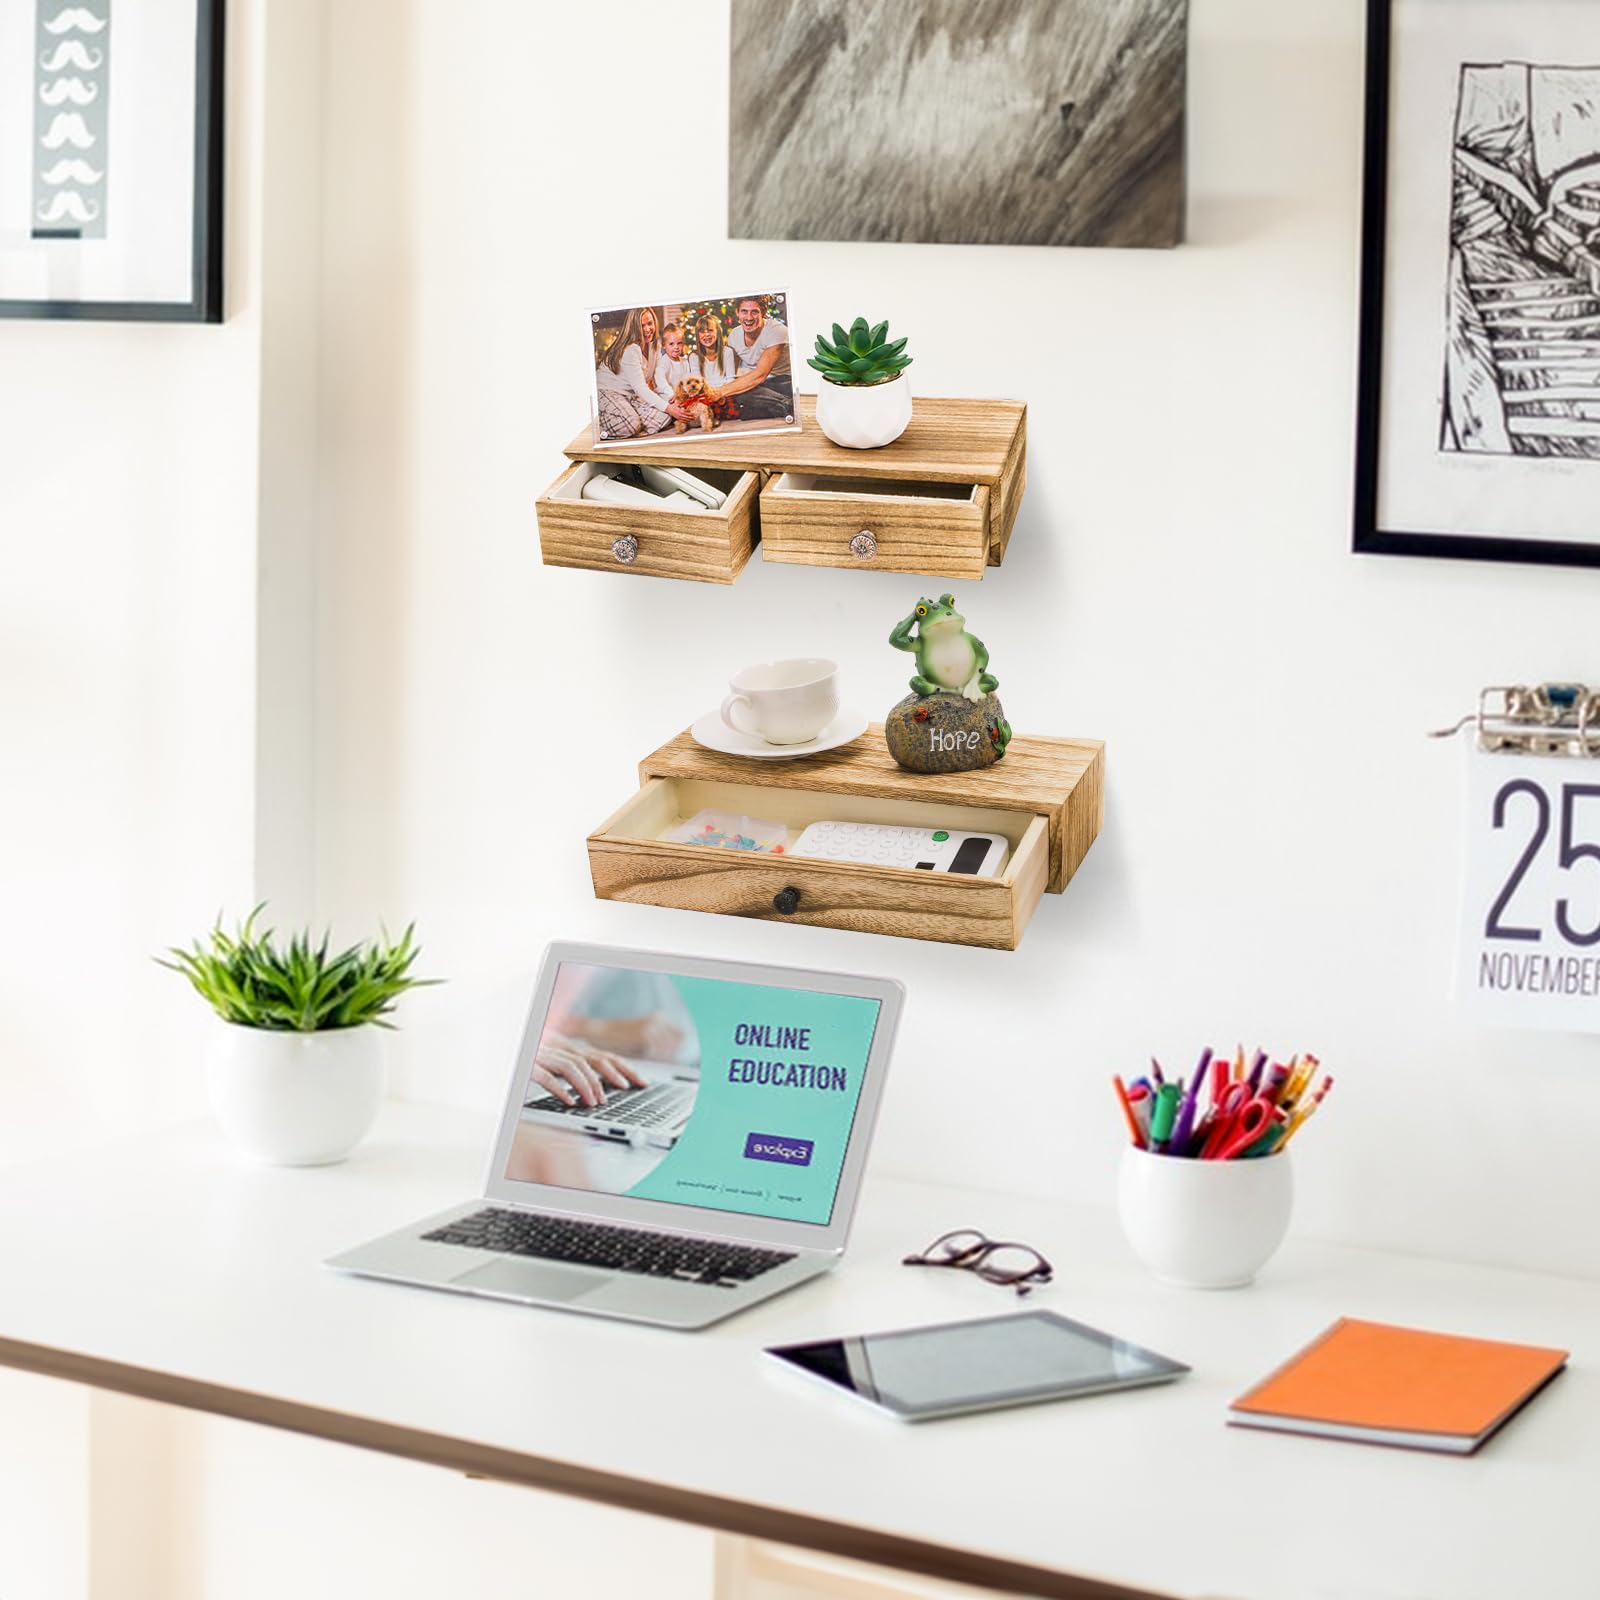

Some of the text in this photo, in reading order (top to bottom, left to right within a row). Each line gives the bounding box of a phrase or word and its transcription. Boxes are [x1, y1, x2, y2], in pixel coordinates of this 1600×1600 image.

[1485, 778, 1600, 947] 25
[734, 1023, 812, 1051] ONLINE
[727, 1058, 847, 1092] EDUCATION
